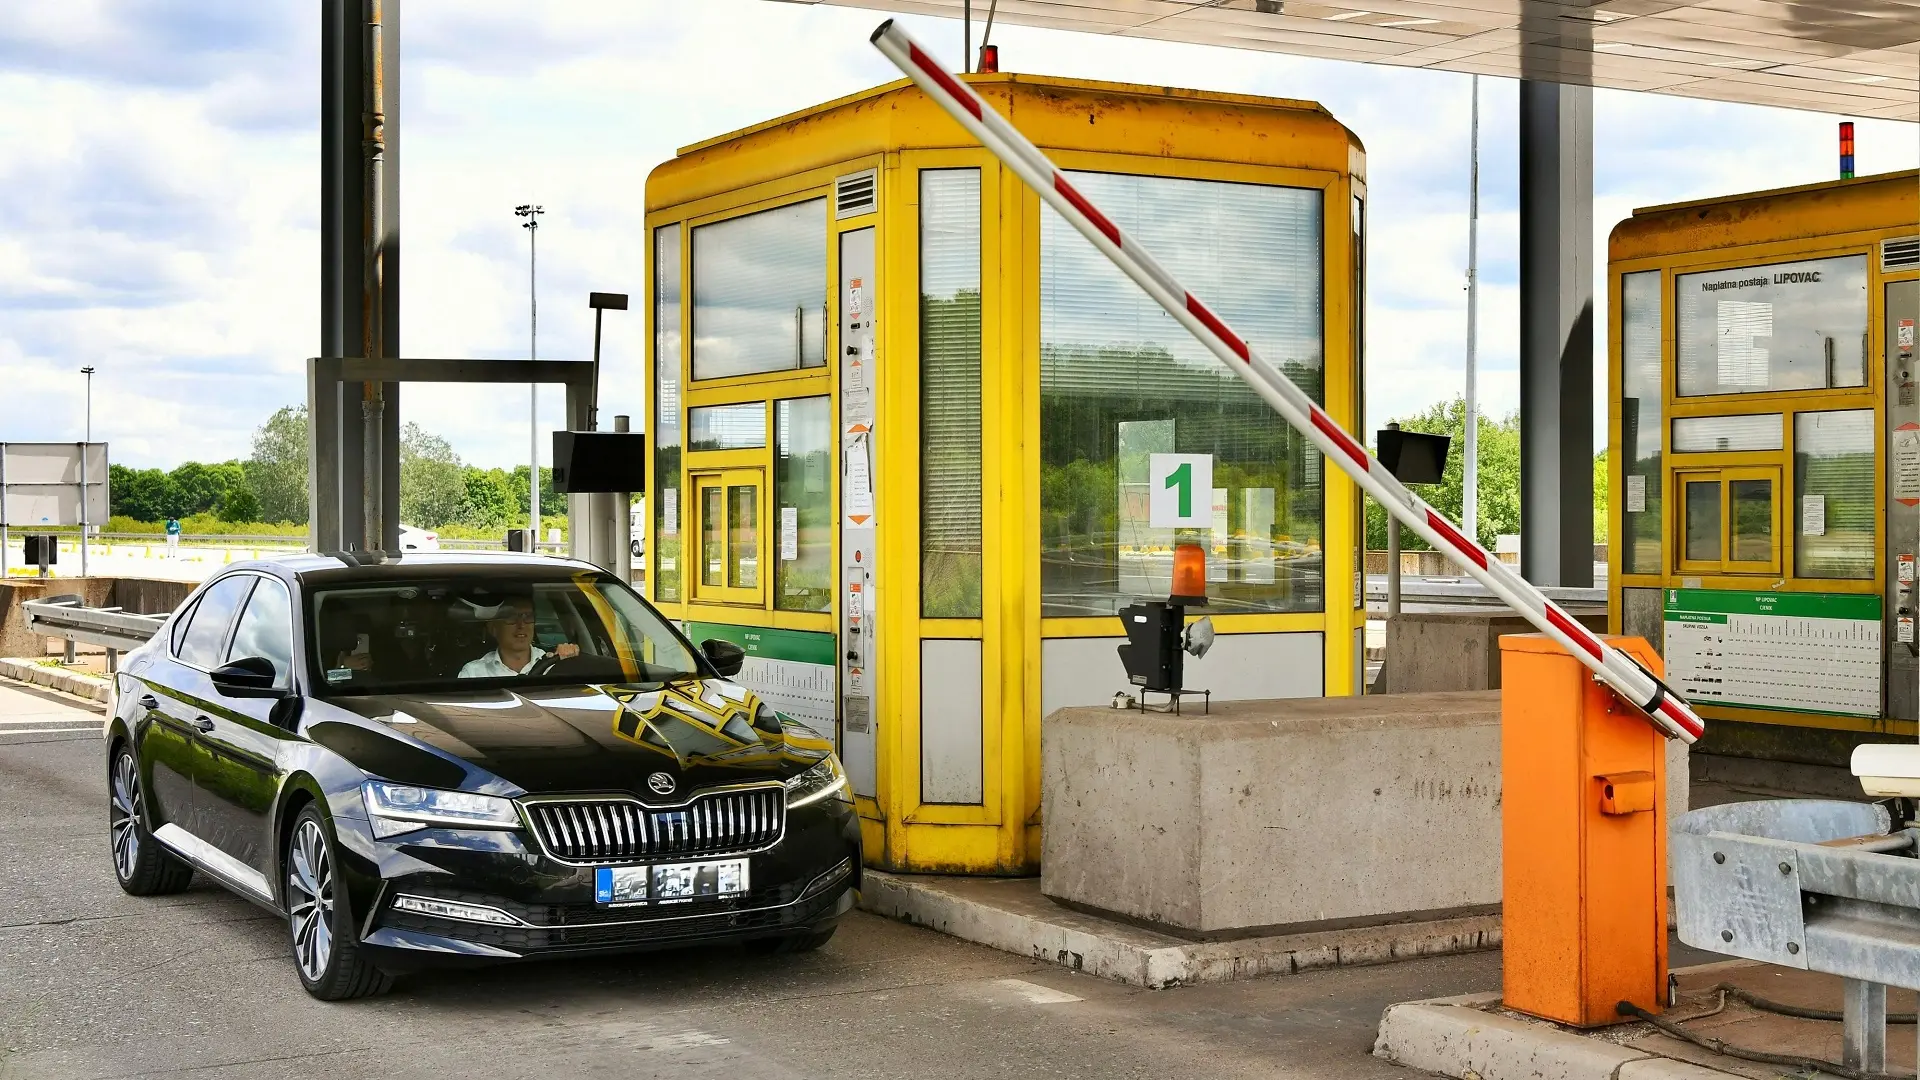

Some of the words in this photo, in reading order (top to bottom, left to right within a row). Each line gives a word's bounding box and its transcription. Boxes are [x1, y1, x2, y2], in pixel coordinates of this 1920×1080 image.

[1702, 280, 1737, 292] Naplatna
[1773, 272, 1820, 285] LIPOVAC
[1165, 463, 1191, 517] 1
